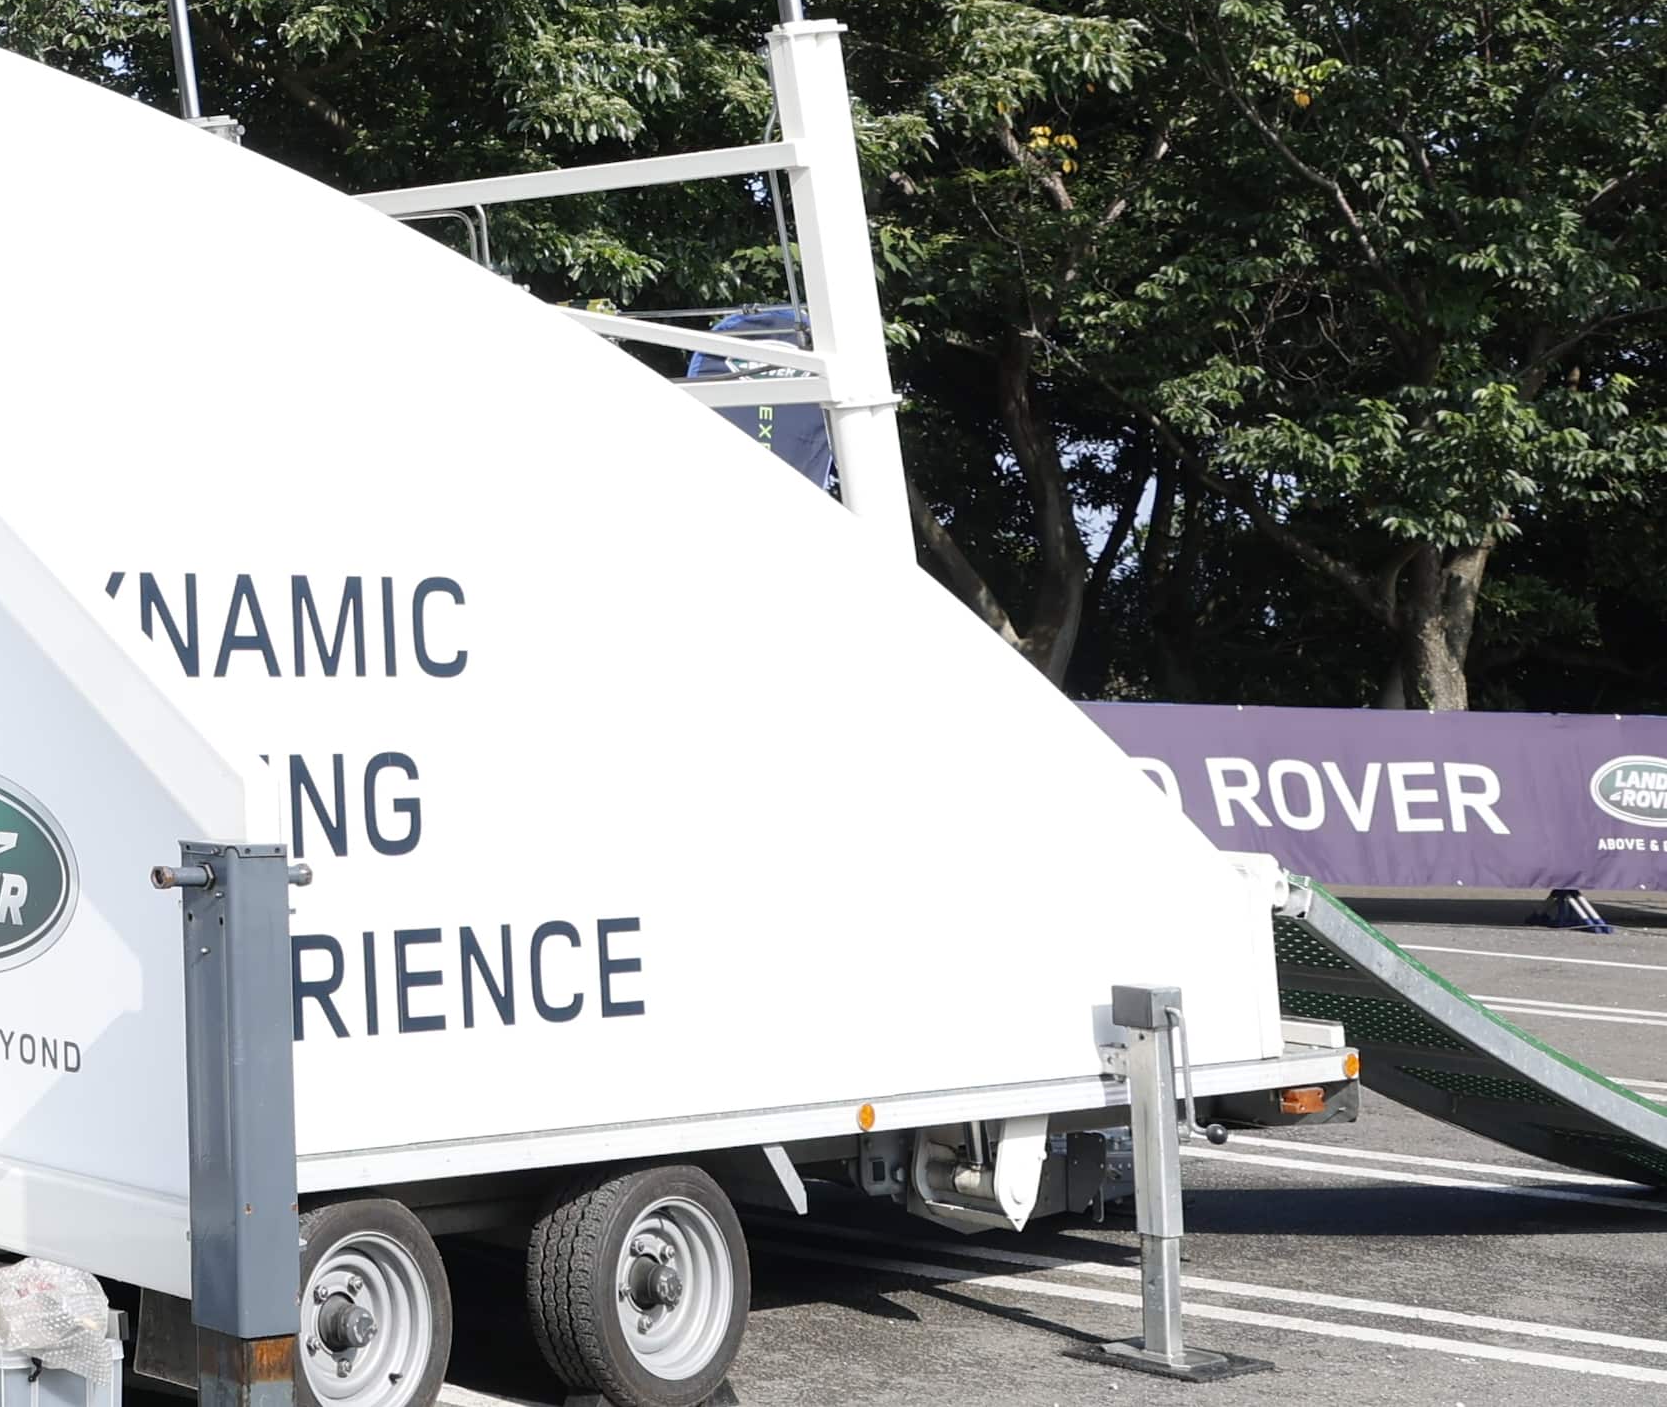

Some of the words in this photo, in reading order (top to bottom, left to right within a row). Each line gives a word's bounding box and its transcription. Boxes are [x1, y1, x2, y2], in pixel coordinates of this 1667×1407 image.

[104, 570, 469, 679] NAMIC
[1204, 756, 1512, 835] ROVER
[1597, 837, 1647, 851] ABOVE
[1649, 839, 1660, 852] &
[290, 916, 646, 1042] RIENCE
